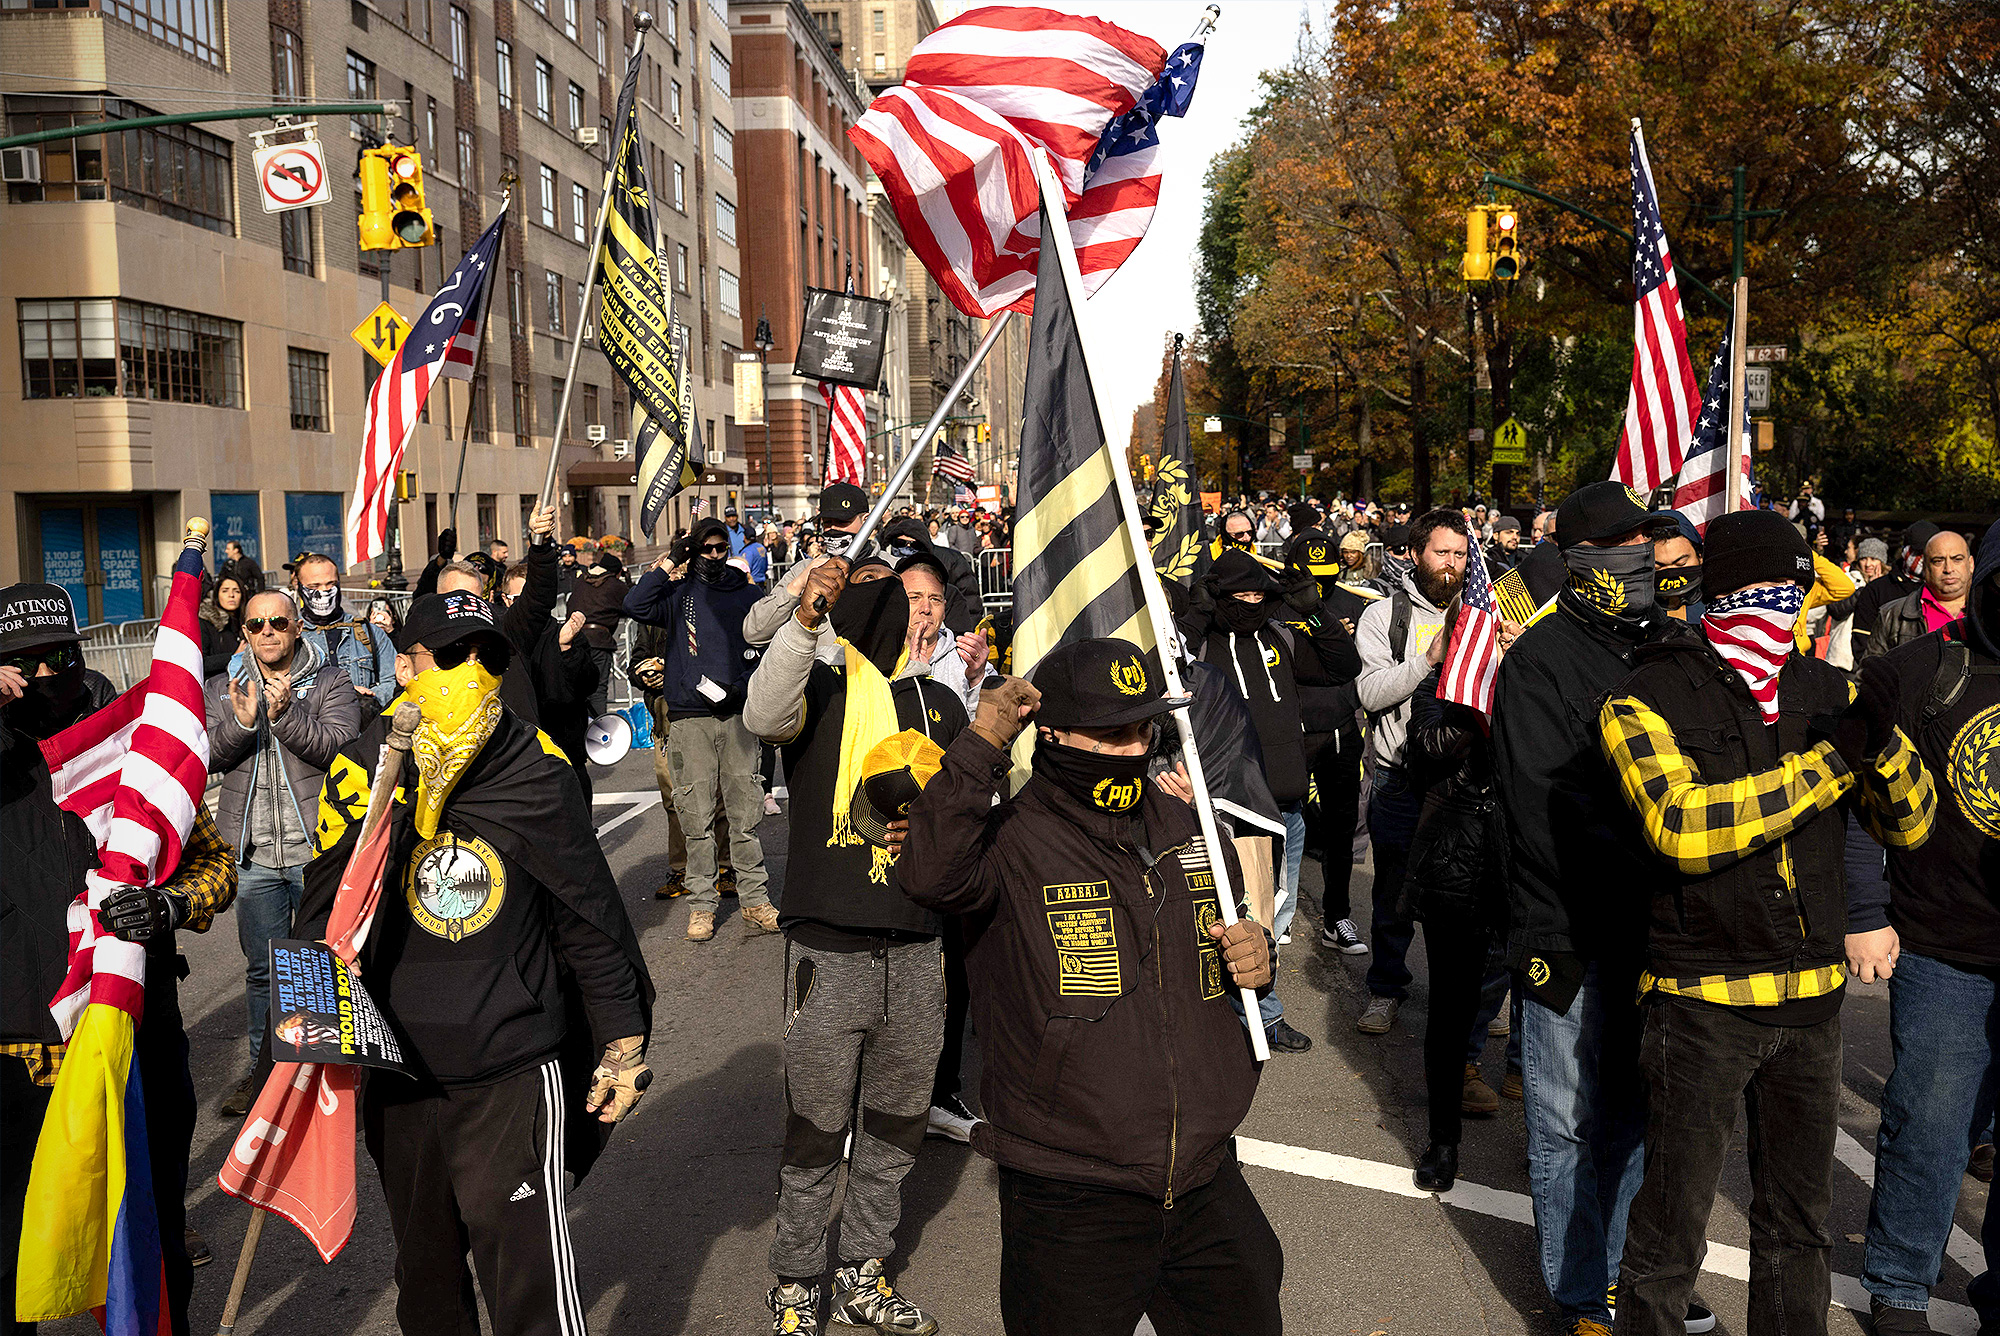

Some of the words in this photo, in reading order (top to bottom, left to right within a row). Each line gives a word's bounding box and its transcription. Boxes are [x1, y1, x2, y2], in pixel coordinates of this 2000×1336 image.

[614, 274, 661, 328] Pro-Gun
[624, 313, 646, 338] the
[625, 339, 644, 362] the
[1746, 348, 1756, 361] W
[1758, 348, 1771, 361] 62
[1774, 347, 1786, 361] ST
[615, 355, 629, 371] of
[628, 366, 678, 423] Western
[1749, 389, 1765, 401] NLY
[44, 560, 84, 569] GROUND
[101, 549, 139, 560] RETAIL
[103, 559, 138, 570] SPACE
[105, 579, 139, 590] LEASE
[110, 569, 132, 579] FOR
[27, 615, 69, 628] TRUMP
[1106, 785, 1134, 808] PB
[410, 843, 430, 865] FIVE
[474, 843, 493, 861] NYC
[413, 903, 442, 930] PROUD
[470, 907, 493, 928] BOYS
[274, 948, 292, 981] LIES
[290, 951, 302, 974] LEFT
[300, 947, 310, 960] TO
[292, 975, 304, 993] THE
[302, 961, 315, 993] MEANT
[319, 950, 337, 1014] DEMORALIZE.
[335, 956, 351, 998] BOYS
[278, 984, 296, 1013] THE
[295, 994, 306, 1007] OF
[305, 993, 317, 1013] ARE
[340, 1000, 355, 1055] PROUD
